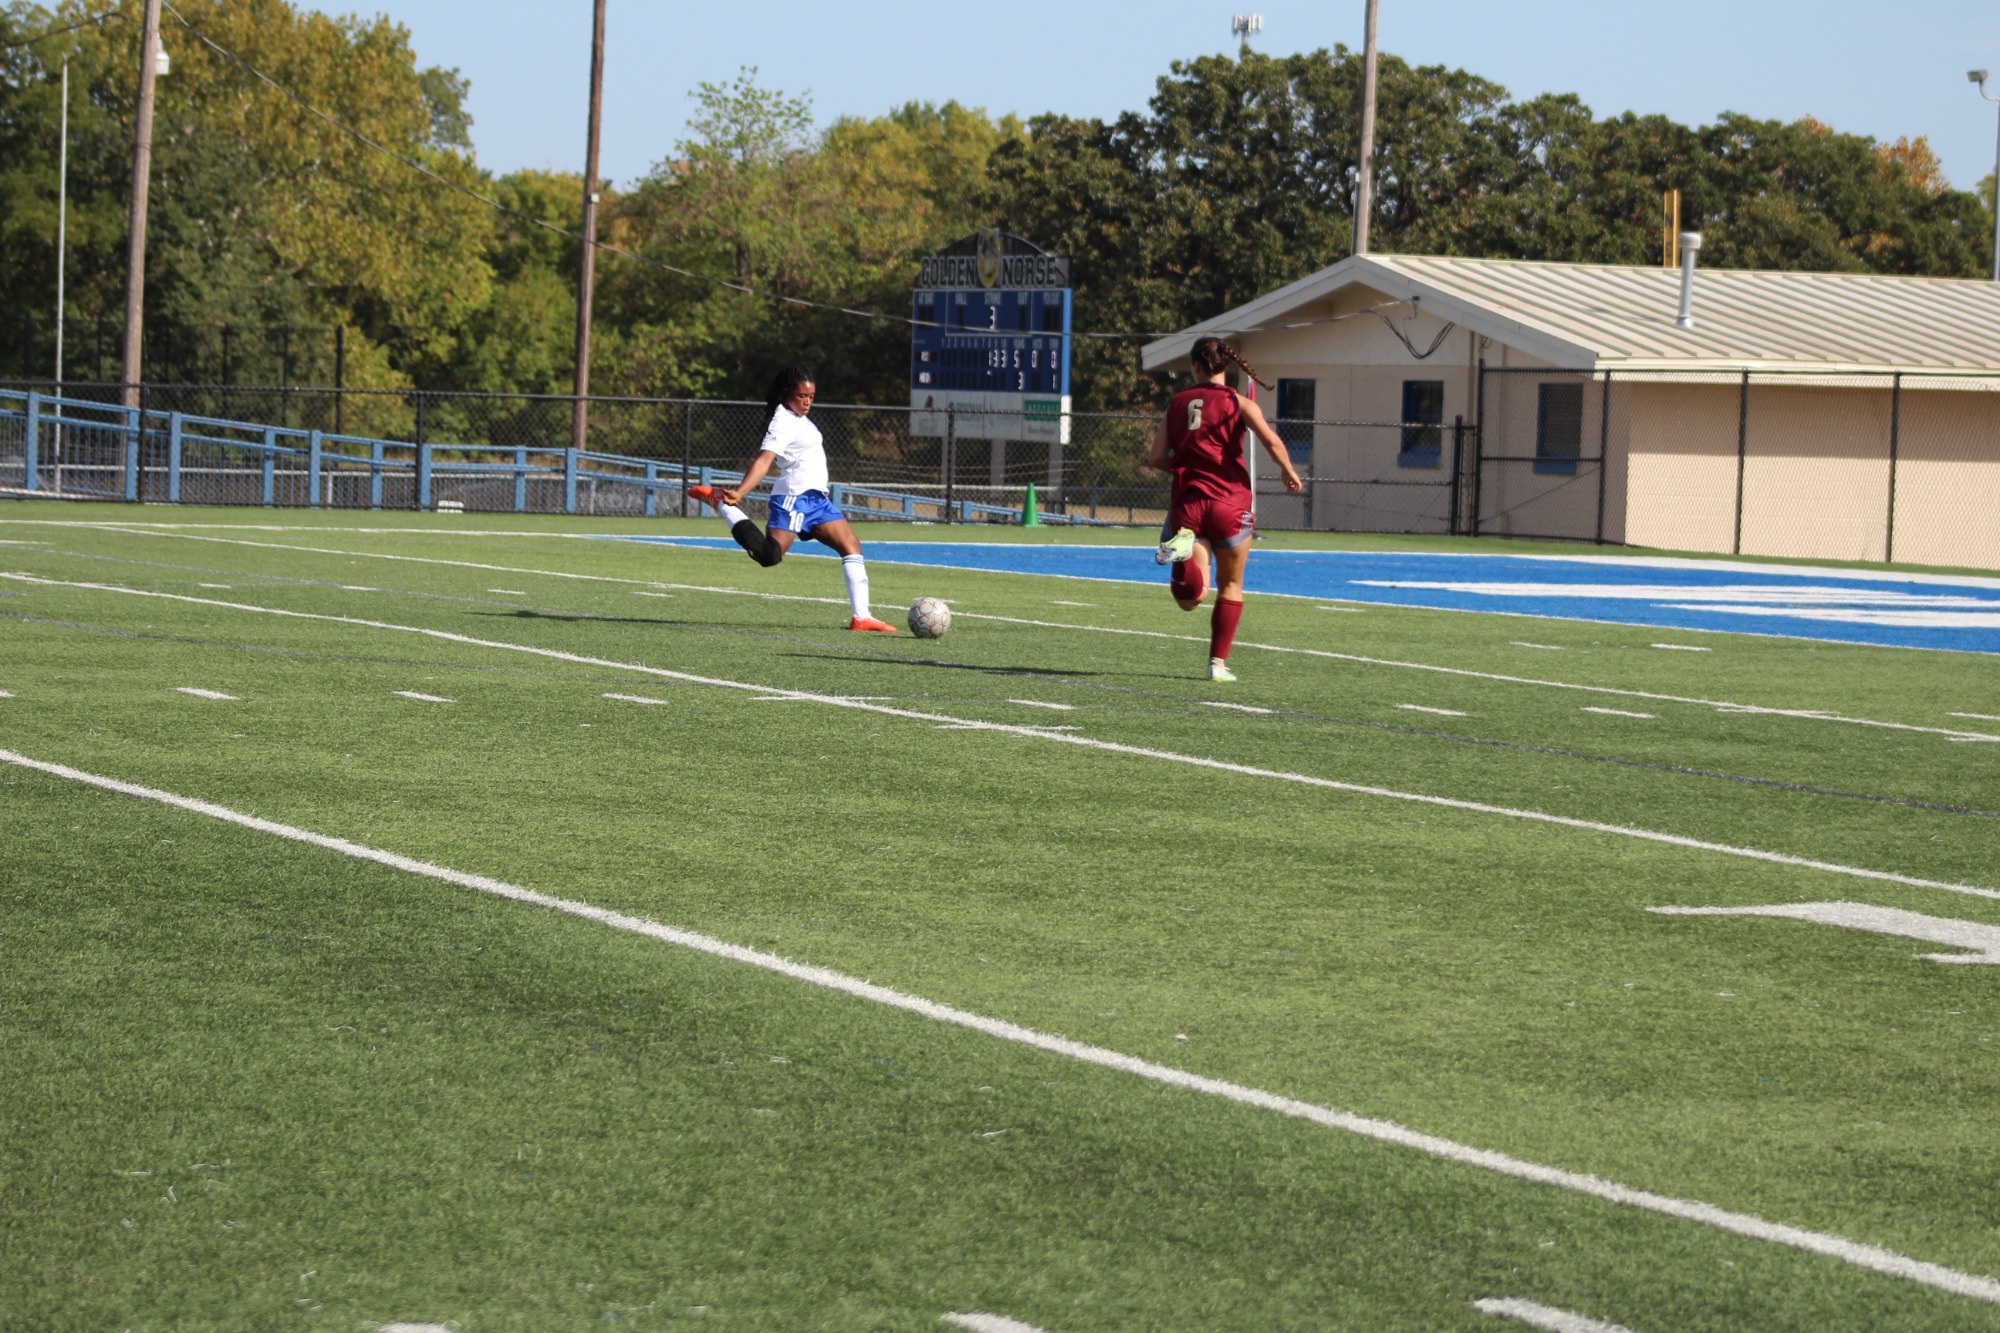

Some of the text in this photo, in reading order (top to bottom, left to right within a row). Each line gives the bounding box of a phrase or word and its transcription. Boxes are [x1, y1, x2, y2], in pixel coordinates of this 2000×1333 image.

[921, 256, 1056, 287] GOLDEN NORSE
[1187, 398, 1204, 431] 6
[788, 510, 805, 533] 10
